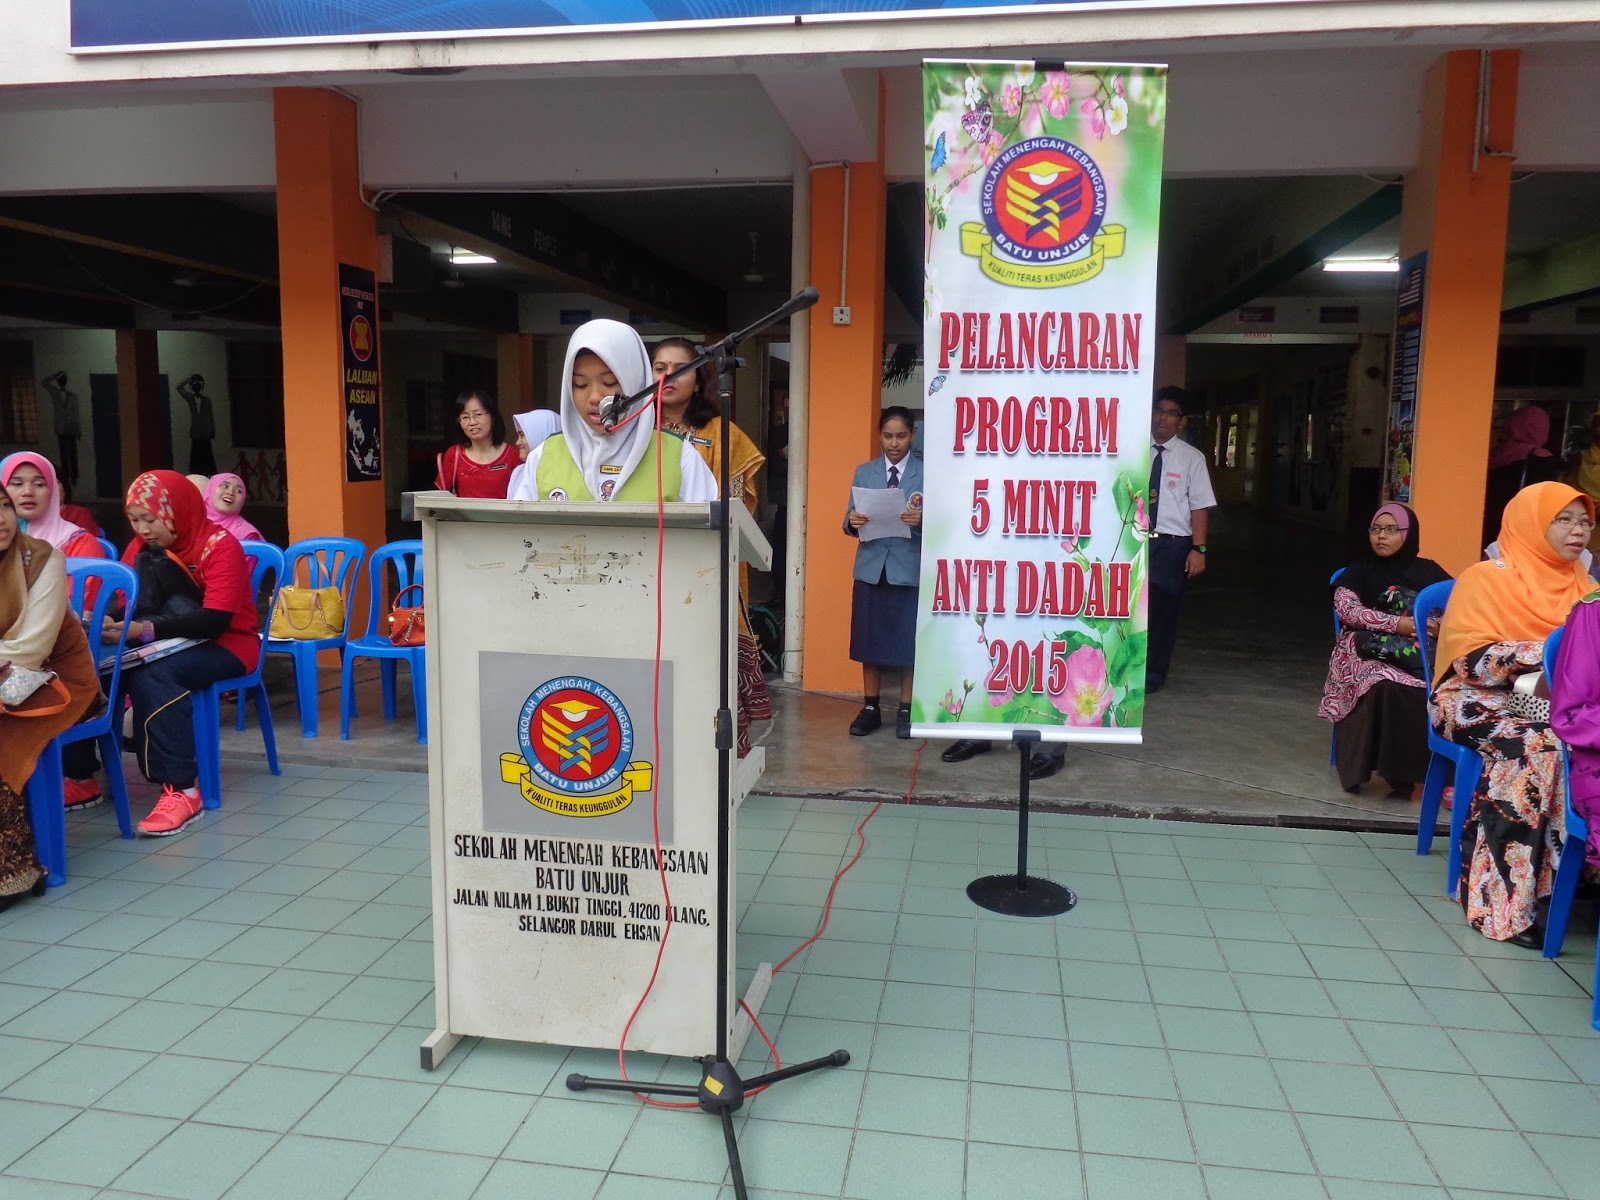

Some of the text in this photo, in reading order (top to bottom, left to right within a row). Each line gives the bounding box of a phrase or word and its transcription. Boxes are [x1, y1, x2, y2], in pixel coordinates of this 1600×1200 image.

[983, 137, 1107, 216] SEKOLAH MENENGAH KEBANGSAAN
[995, 233, 1090, 260] BATU UNJUR
[987, 260, 1098, 284] KUALITI TERAS KEUNGGULAN
[938, 310, 1142, 372] PELANCARAN
[346, 368, 378, 386] LALUAN
[349, 389, 376, 405] ASEAN
[952, 395, 1120, 456] PROGRAM
[970, 478, 1098, 538] 5 MINIT
[931, 558, 1132, 619] ANTI DADAH
[987, 638, 1068, 696] 2015
[520, 678, 631, 752] SEKOLAH MENENGAH KEBANGSAAN
[533, 762, 618, 791] BATU UNJUR
[525, 786, 628, 813] KUALITI TERAS KEUNGGULAN
[453, 834, 709, 875] SEKOLAH MENENGAH KEBANGSAAN
[536, 867, 630, 896] BATU UNJUR
[453, 888, 489, 907] JALAN
[494, 891, 532, 911] NILAM
[519, 915, 661, 943] SELANGOR DARUL EHSAN
